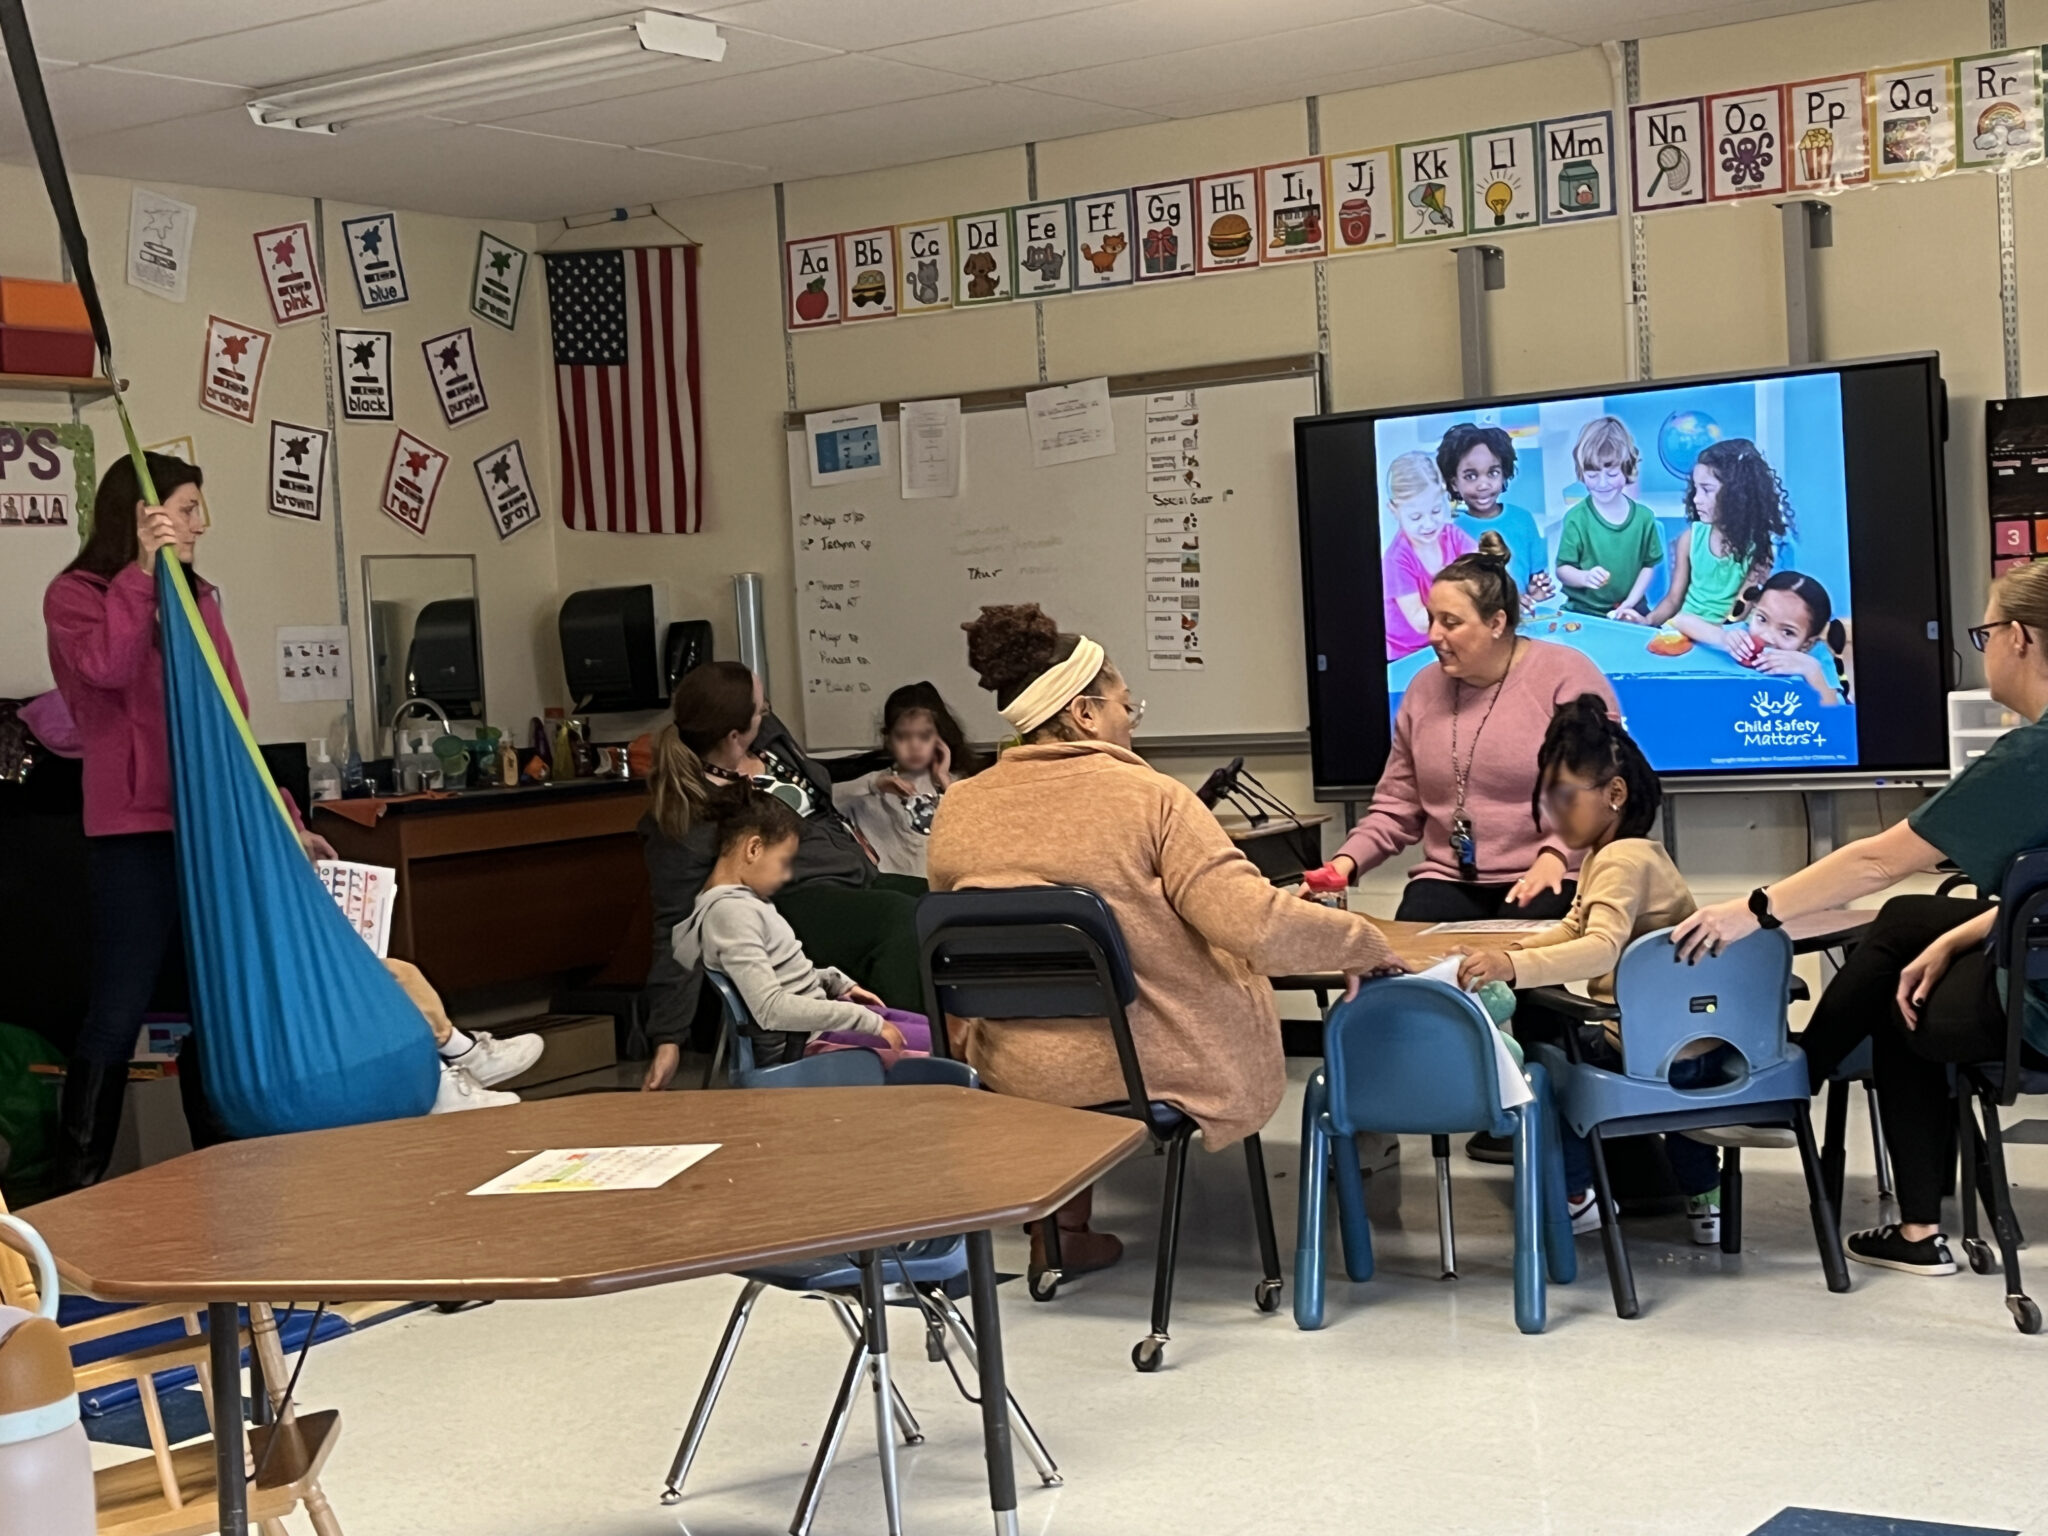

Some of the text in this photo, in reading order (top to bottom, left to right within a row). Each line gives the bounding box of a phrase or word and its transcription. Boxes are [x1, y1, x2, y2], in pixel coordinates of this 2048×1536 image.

[1977, 67, 2018, 98] Rr
[1808, 92, 1845, 128] Pp
[1890, 79, 1938, 114] Qq
[1649, 116, 1686, 145] Nn
[1725, 104, 1767, 134] Oo
[1550, 129, 1603, 160] Mm
[1348, 162, 1374, 197] Jj
[1414, 152, 1447, 181] Kk
[1148, 194, 1180, 226] Gg
[1211, 185, 1246, 212] Hh
[1027, 213, 1057, 240] Ee
[1087, 204, 1115, 231] Ff
[912, 232, 940, 257] Cc
[968, 222, 998, 249] Dd
[801, 250, 829, 274] Aa
[856, 241, 883, 266] Bb
[283, 290, 314, 316] pink
[369, 284, 397, 302] blue
[206, 386, 250, 412] orange
[349, 396, 387, 413] black
[448, 393, 482, 416] purple
[276, 490, 315, 512] brown
[391, 493, 422, 525] red
[502, 503, 532, 530] gray
[2008, 529, 2020, 545] 3
[1734, 718, 1820, 735] Child Safety
